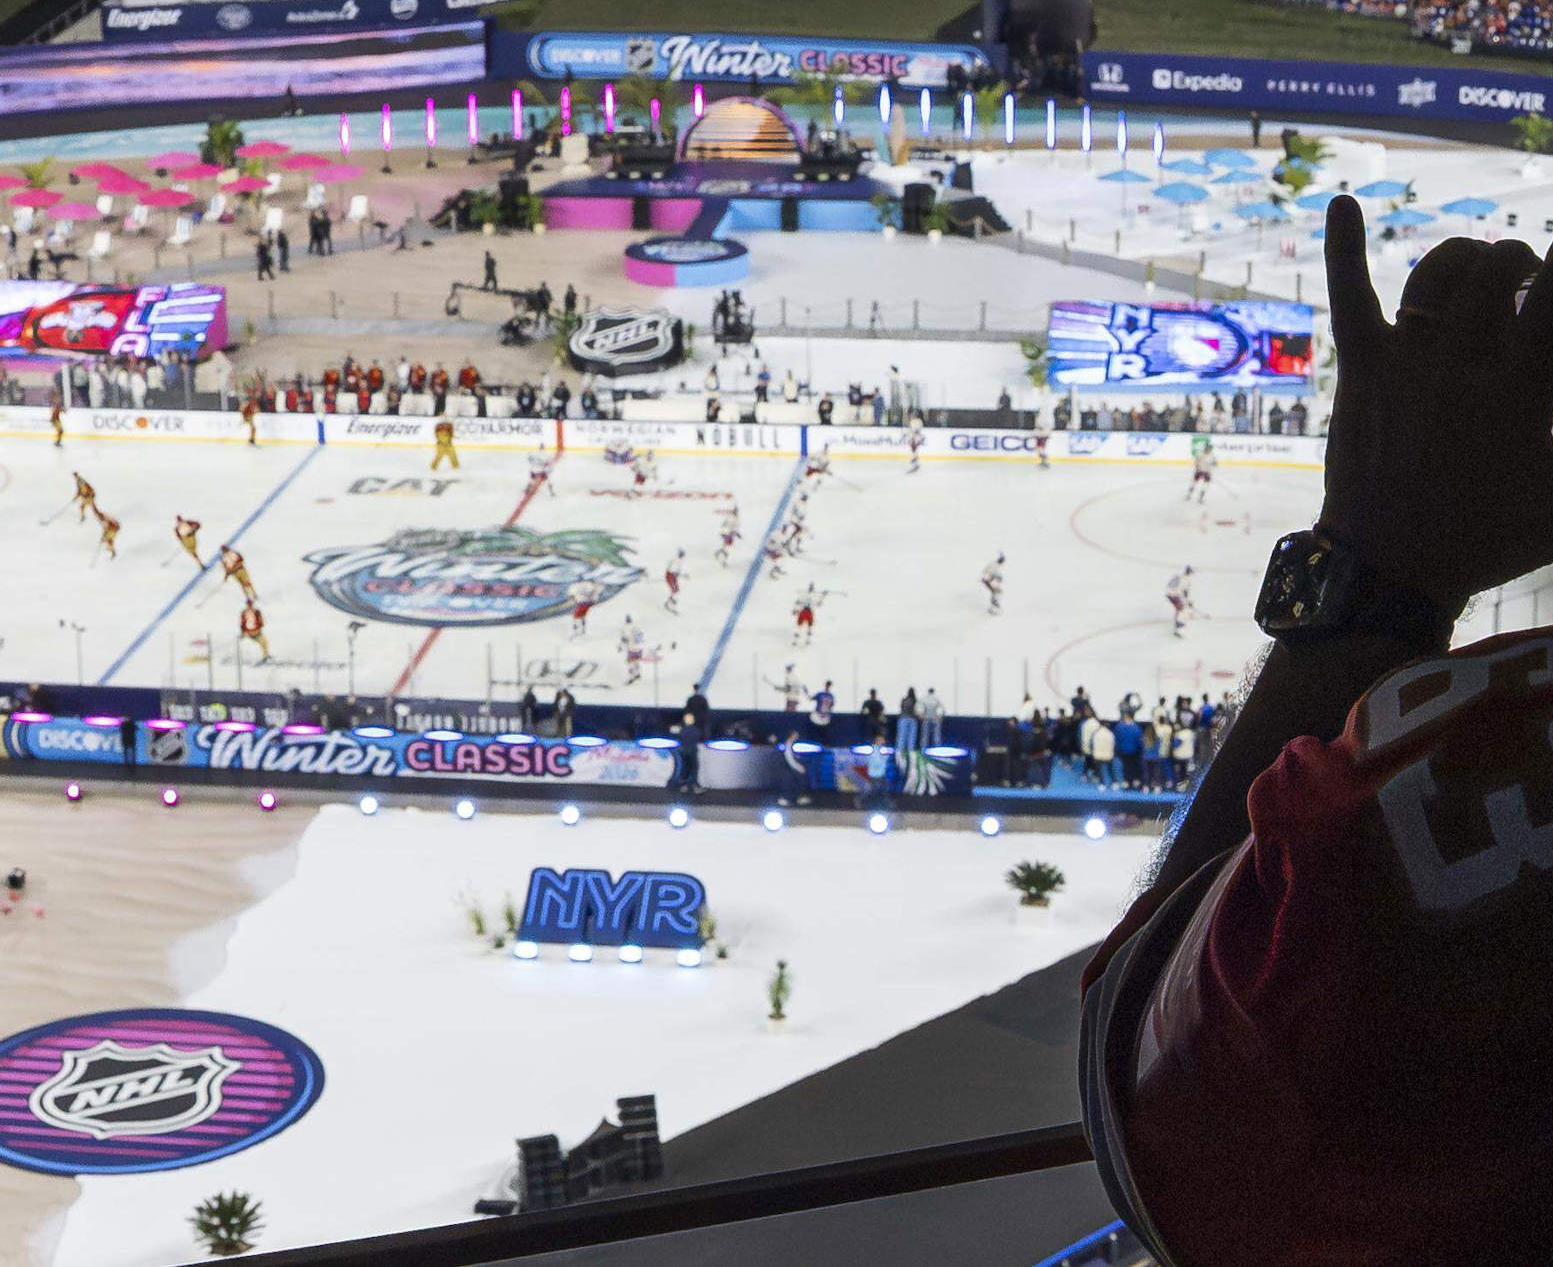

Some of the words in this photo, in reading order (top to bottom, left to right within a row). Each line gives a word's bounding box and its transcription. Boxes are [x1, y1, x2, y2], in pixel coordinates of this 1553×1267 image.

[659, 35, 793, 81] Winter
[799, 49, 909, 77] CLASSIC
[1458, 84, 1547, 113] DISCOVER
[92, 415, 185, 432] DISCOVER
[38, 727, 126, 754] DISCOVE
[196, 725, 397, 777] Winter
[407, 740, 575, 777] CLASSIC
[524, 867, 703, 937] NYR
[67, 1069, 200, 1114] NHL
